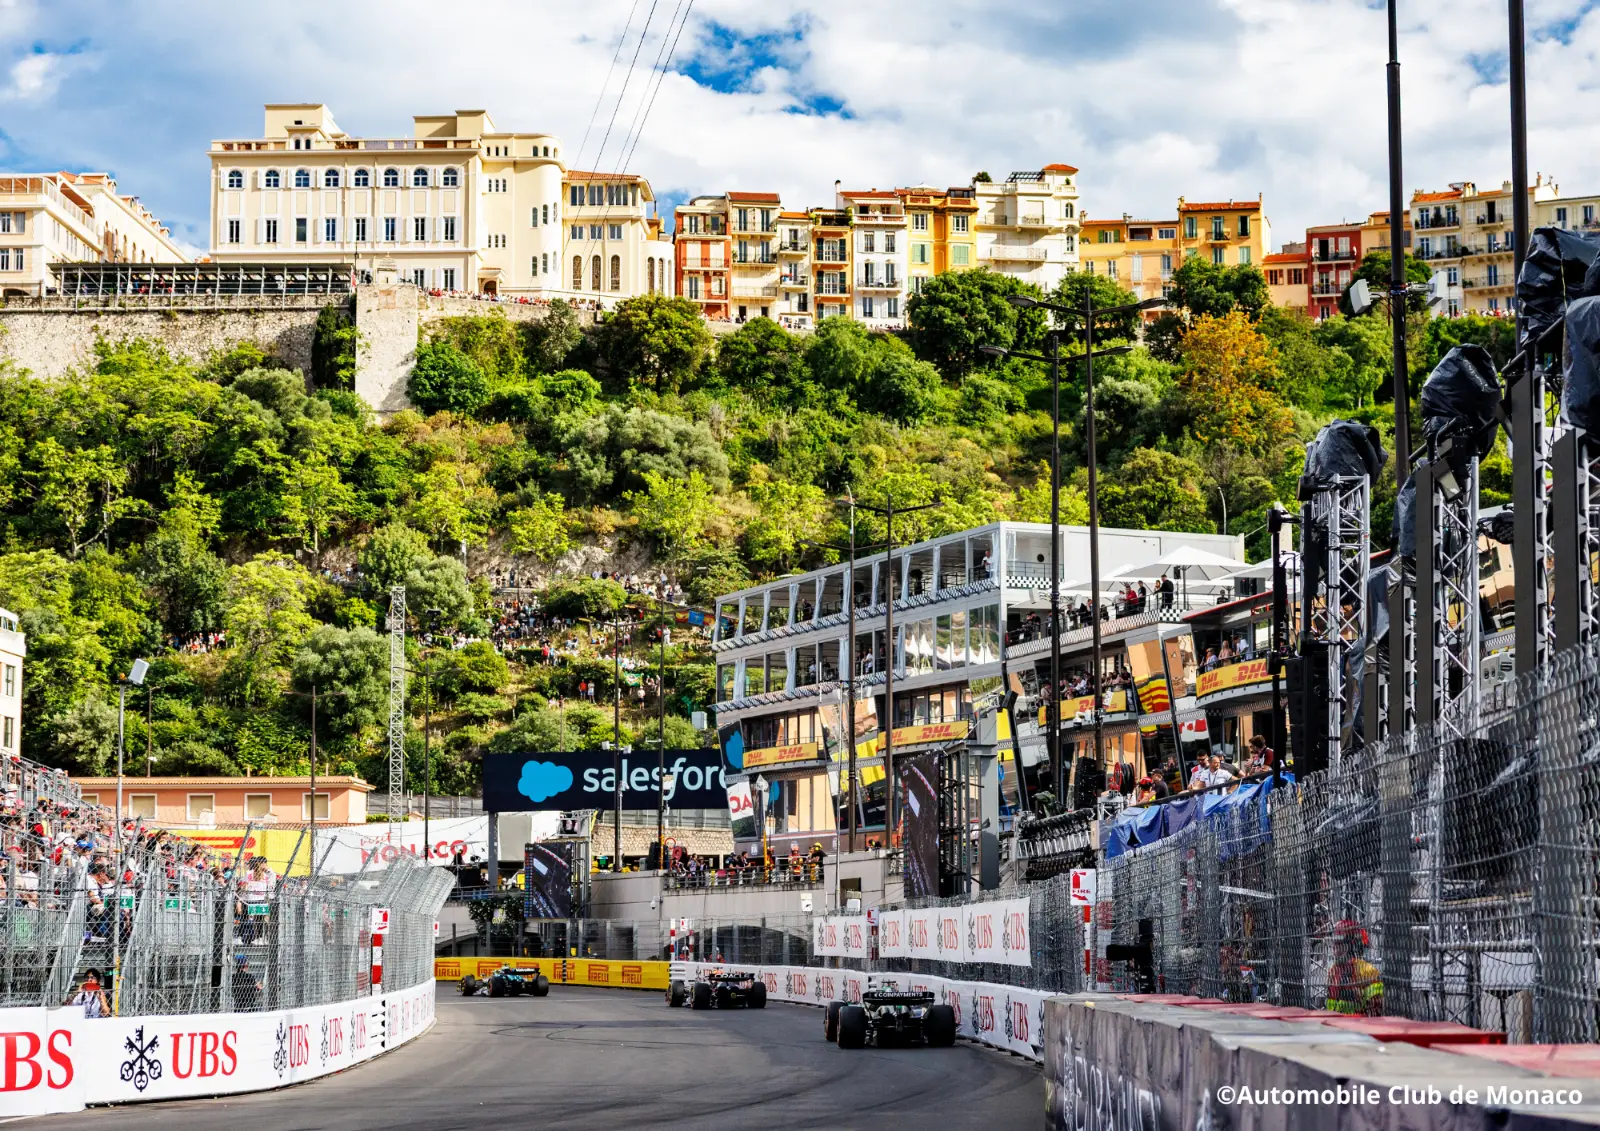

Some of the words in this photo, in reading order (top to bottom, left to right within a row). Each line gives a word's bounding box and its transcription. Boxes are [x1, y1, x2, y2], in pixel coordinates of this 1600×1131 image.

[922, 725, 952, 739] DHL
[777, 746, 805, 760] DHL
[914, 919, 928, 948] UBS
[943, 918, 958, 950] UBS
[976, 914, 993, 949] UBS
[1010, 912, 1026, 951] UBS
[435, 962, 460, 977] PIRELLI
[588, 964, 609, 983] PIRELLI
[622, 966, 642, 985] PIRELLI
[793, 973, 807, 996] UBS
[822, 976, 835, 999] UBS
[980, 995, 995, 1032] UBS
[1013, 1001, 1029, 1043] UBS
[289, 1023, 309, 1068] UBS
[329, 1016, 343, 1057] UBS
[0, 1029, 74, 1092] BS
[170, 1030, 238, 1080] UBS
